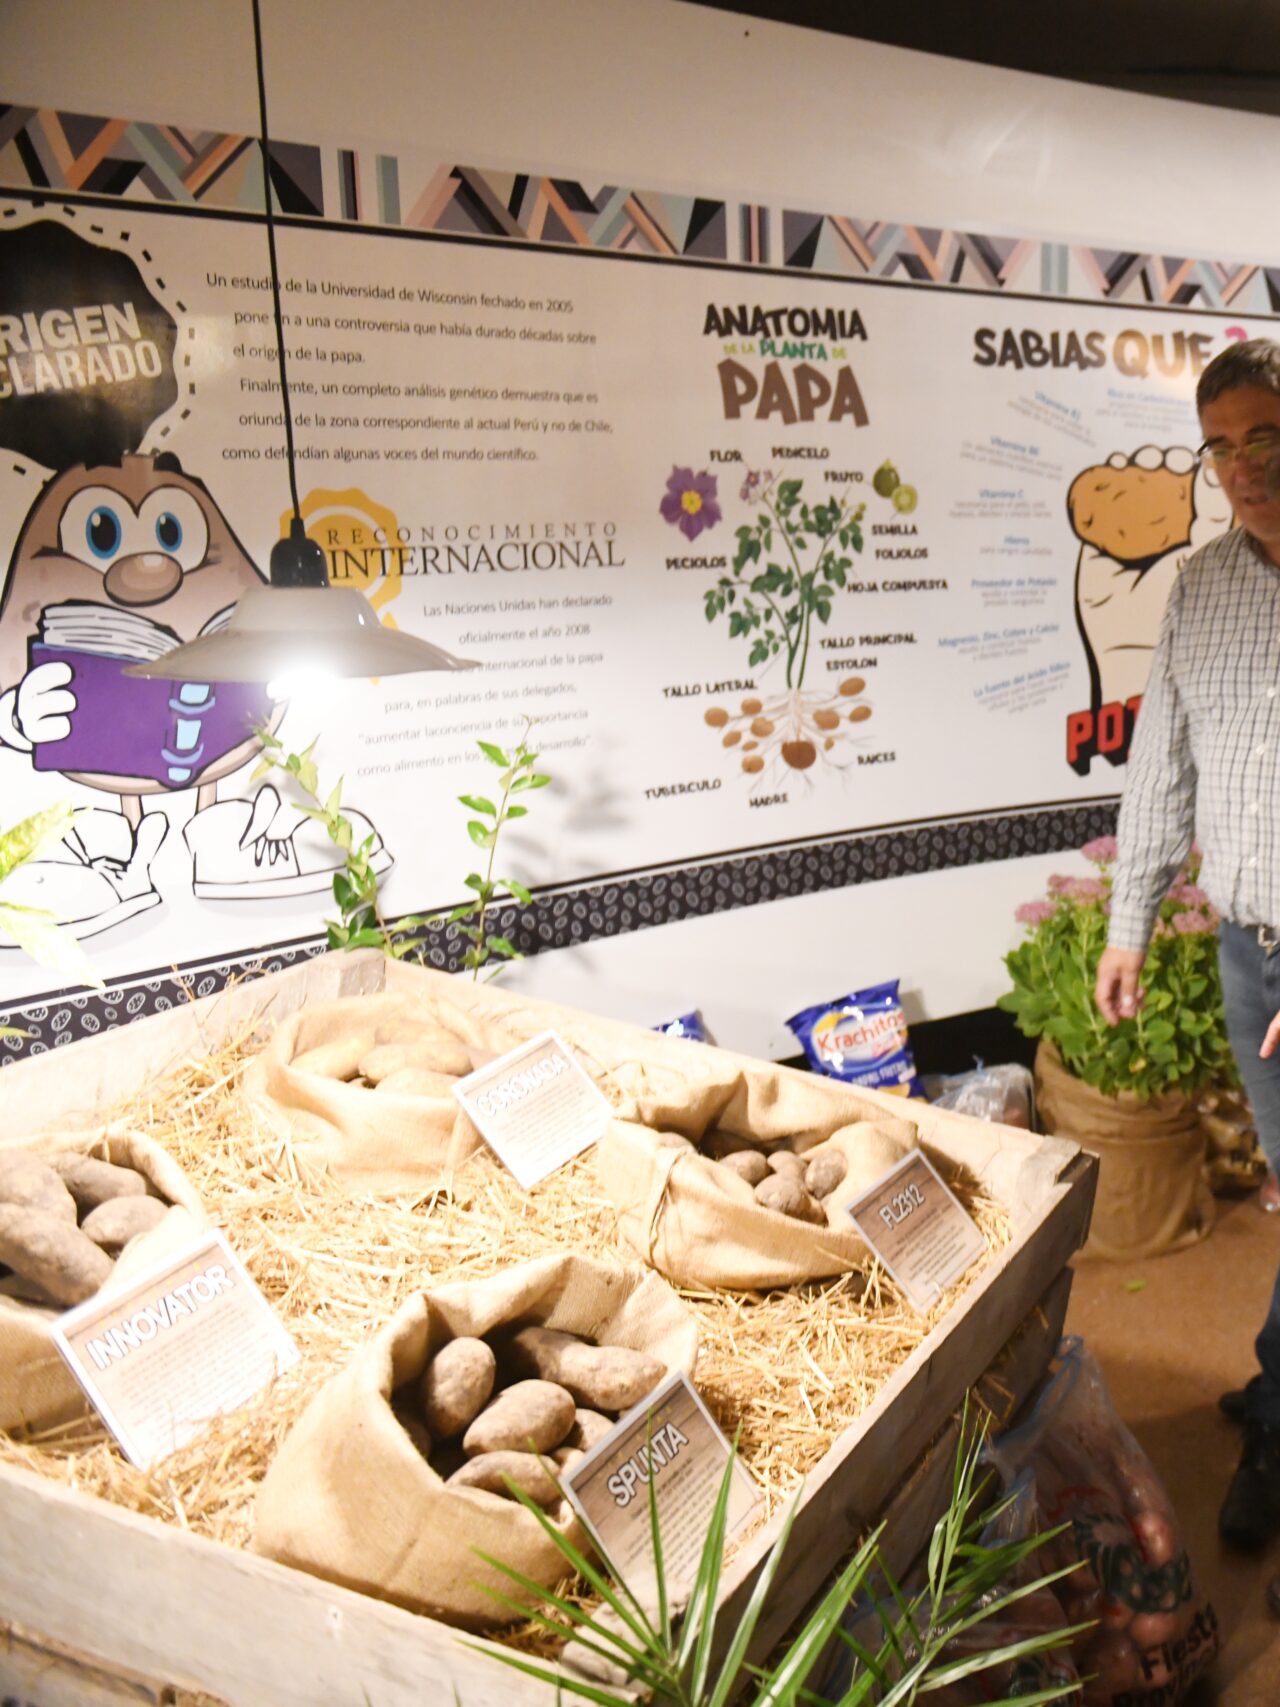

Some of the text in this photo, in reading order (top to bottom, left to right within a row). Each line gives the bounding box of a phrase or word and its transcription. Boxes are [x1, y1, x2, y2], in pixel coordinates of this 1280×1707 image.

[206, 273, 227, 288] Un
[285, 278, 302, 293] de
[306, 279, 318, 294] la
[321, 281, 395, 300] Universidad
[399, 285, 414, 302] de
[417, 289, 477, 305] Wisconsin
[480, 293, 526, 310] fechado
[529, 300, 543, 311] en
[546, 299, 574, 313] 2005
[234, 311, 269, 326] pone
[294, 316, 302, 327] a
[306, 316, 331, 328] una
[334, 316, 410, 333] controversia
[413, 323, 437, 337] que
[440, 322, 472, 337] había
[475, 325, 516, 340] durado
[519, 328, 564, 343] décadas
[566, 330, 597, 345] sobre
[703, 303, 868, 341] ANATOMIA
[232, 343, 245, 357] el
[295, 346, 312, 360] de
[316, 347, 327, 361] la
[759, 339, 828, 361] PLANTA
[973, 327, 1213, 380] SABIAS QUE
[322, 383, 338, 394] un
[342, 381, 401, 398] completo
[404, 382, 446, 398] análisis
[450, 386, 499, 402] genético
[501, 387, 560, 402] demuestra
[563, 392, 583, 406] que
[586, 393, 599, 403] es
[717, 358, 869, 427] PAPA
[295, 413, 311, 427] de
[315, 413, 326, 427] la
[330, 416, 359, 428] zona
[363, 413, 460, 431] correspondiente
[464, 416, 474, 429] al
[477, 418, 511, 430] actual
[541, 422, 549, 434] y
[551, 421, 566, 433] no
[568, 419, 582, 433] de
[222, 447, 261, 460] como
[264, 446, 329, 460] defndían
[333, 446, 381, 463] algunas
[384, 449, 417, 461] voces
[421, 447, 439, 461] del
[442, 447, 484, 461] mundo
[710, 450, 743, 463] FLOR
[824, 471, 863, 483] FRUTO
[327, 522, 617, 545] RECONOCIMIENTO
[330, 540, 625, 579] INTERNACIONAL
[847, 579, 948, 593] HOJA COMPUESTA
[423, 593, 613, 617] Las Naciones Unidas han declarado
[458, 623, 591, 645] oficialmente el año 2008
[819, 633, 917, 650] TALLO PRINCIPAL
[552, 654, 565, 666] de
[567, 653, 575, 665] la
[578, 652, 604, 666] papa
[417, 698, 432, 709] en
[435, 691, 483, 709] palabras
[485, 688, 499, 701] de
[501, 688, 520, 699] sus
[662, 679, 758, 698] TALLO LATERAL
[495, 717, 509, 729] de
[512, 717, 524, 727] su
[357, 764, 392, 777] como
[394, 754, 445, 772] alimento
[447, 754, 463, 765] en
[465, 750, 480, 763] los
[645, 779, 722, 800] TUBERCULO
[85, 1265, 235, 1370] INNOVATOR
[607, 1422, 689, 1507] SPUNTA
